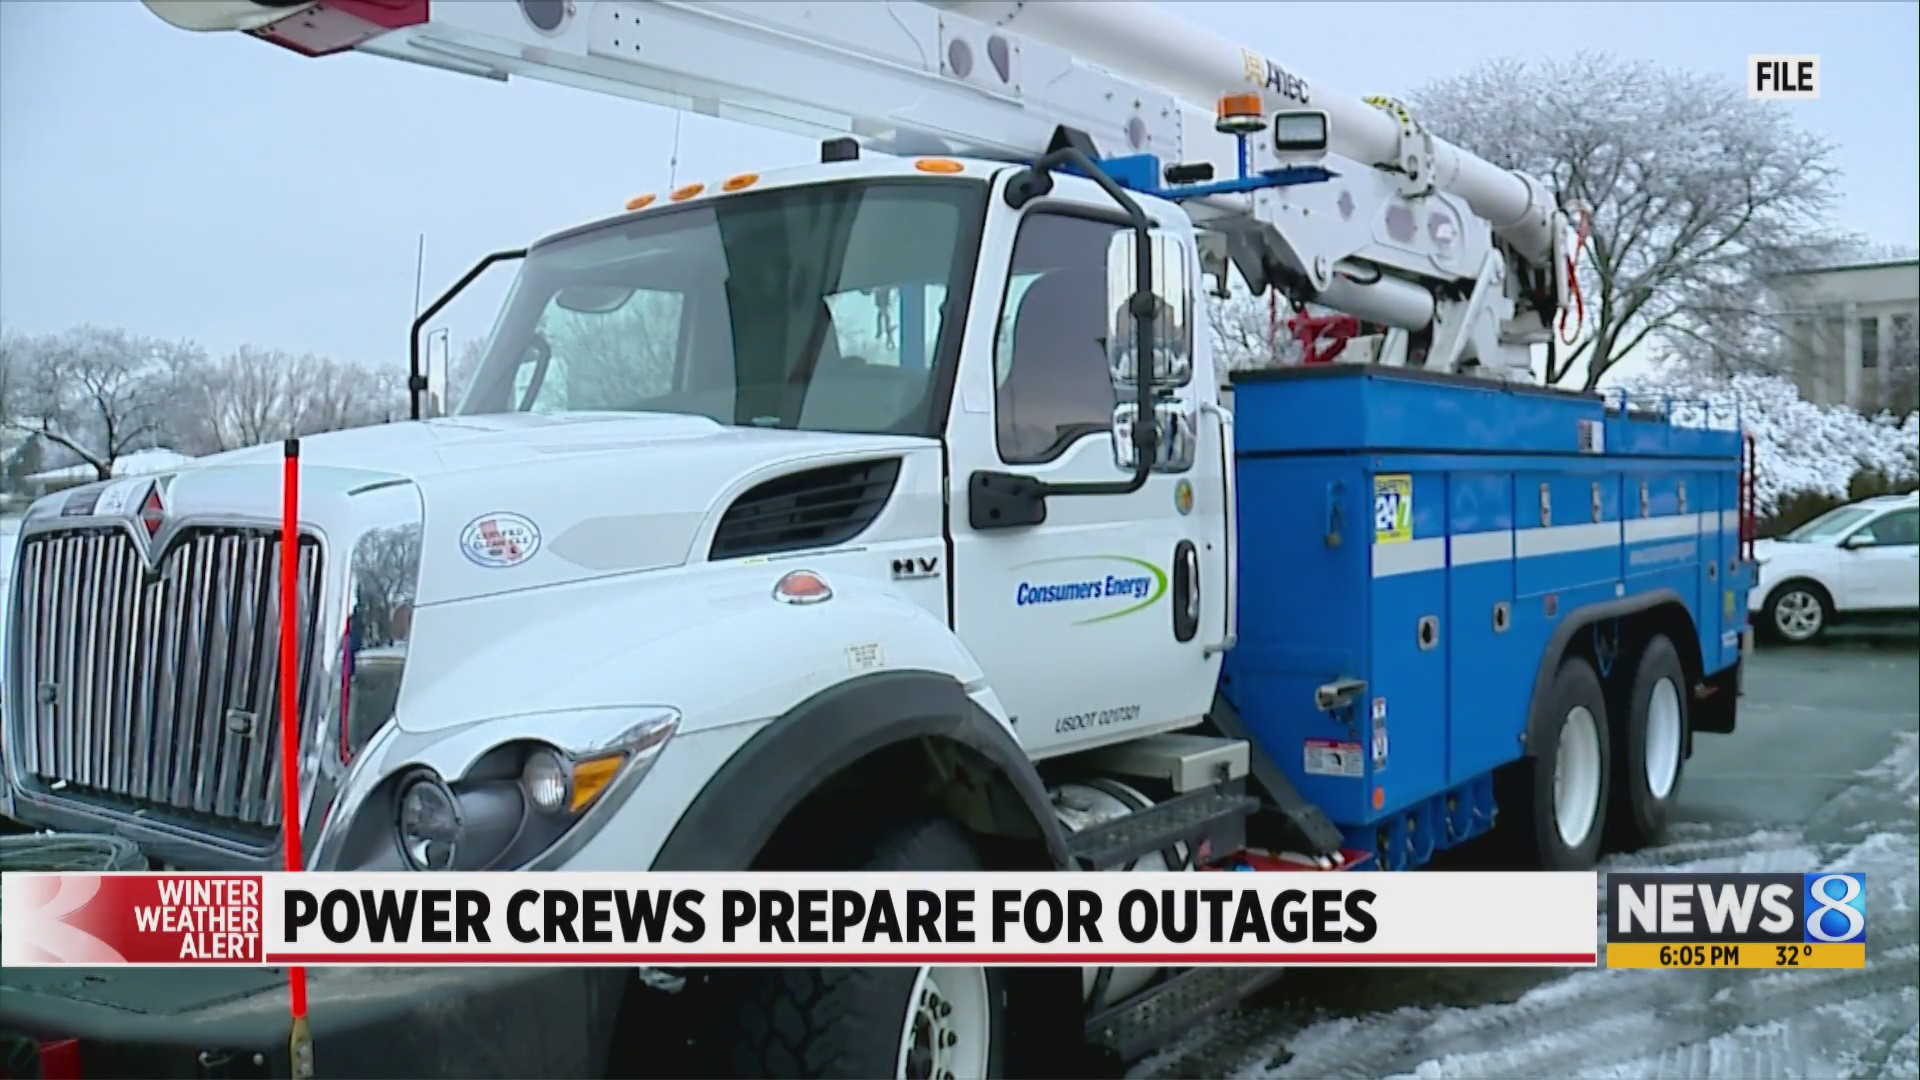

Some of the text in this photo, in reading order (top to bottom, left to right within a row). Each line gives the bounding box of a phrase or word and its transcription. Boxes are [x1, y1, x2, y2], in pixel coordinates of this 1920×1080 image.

[893, 556, 938, 574] HV
[1017, 575, 1151, 606] Consumers Energy
[1055, 711, 1098, 734] USDOT
